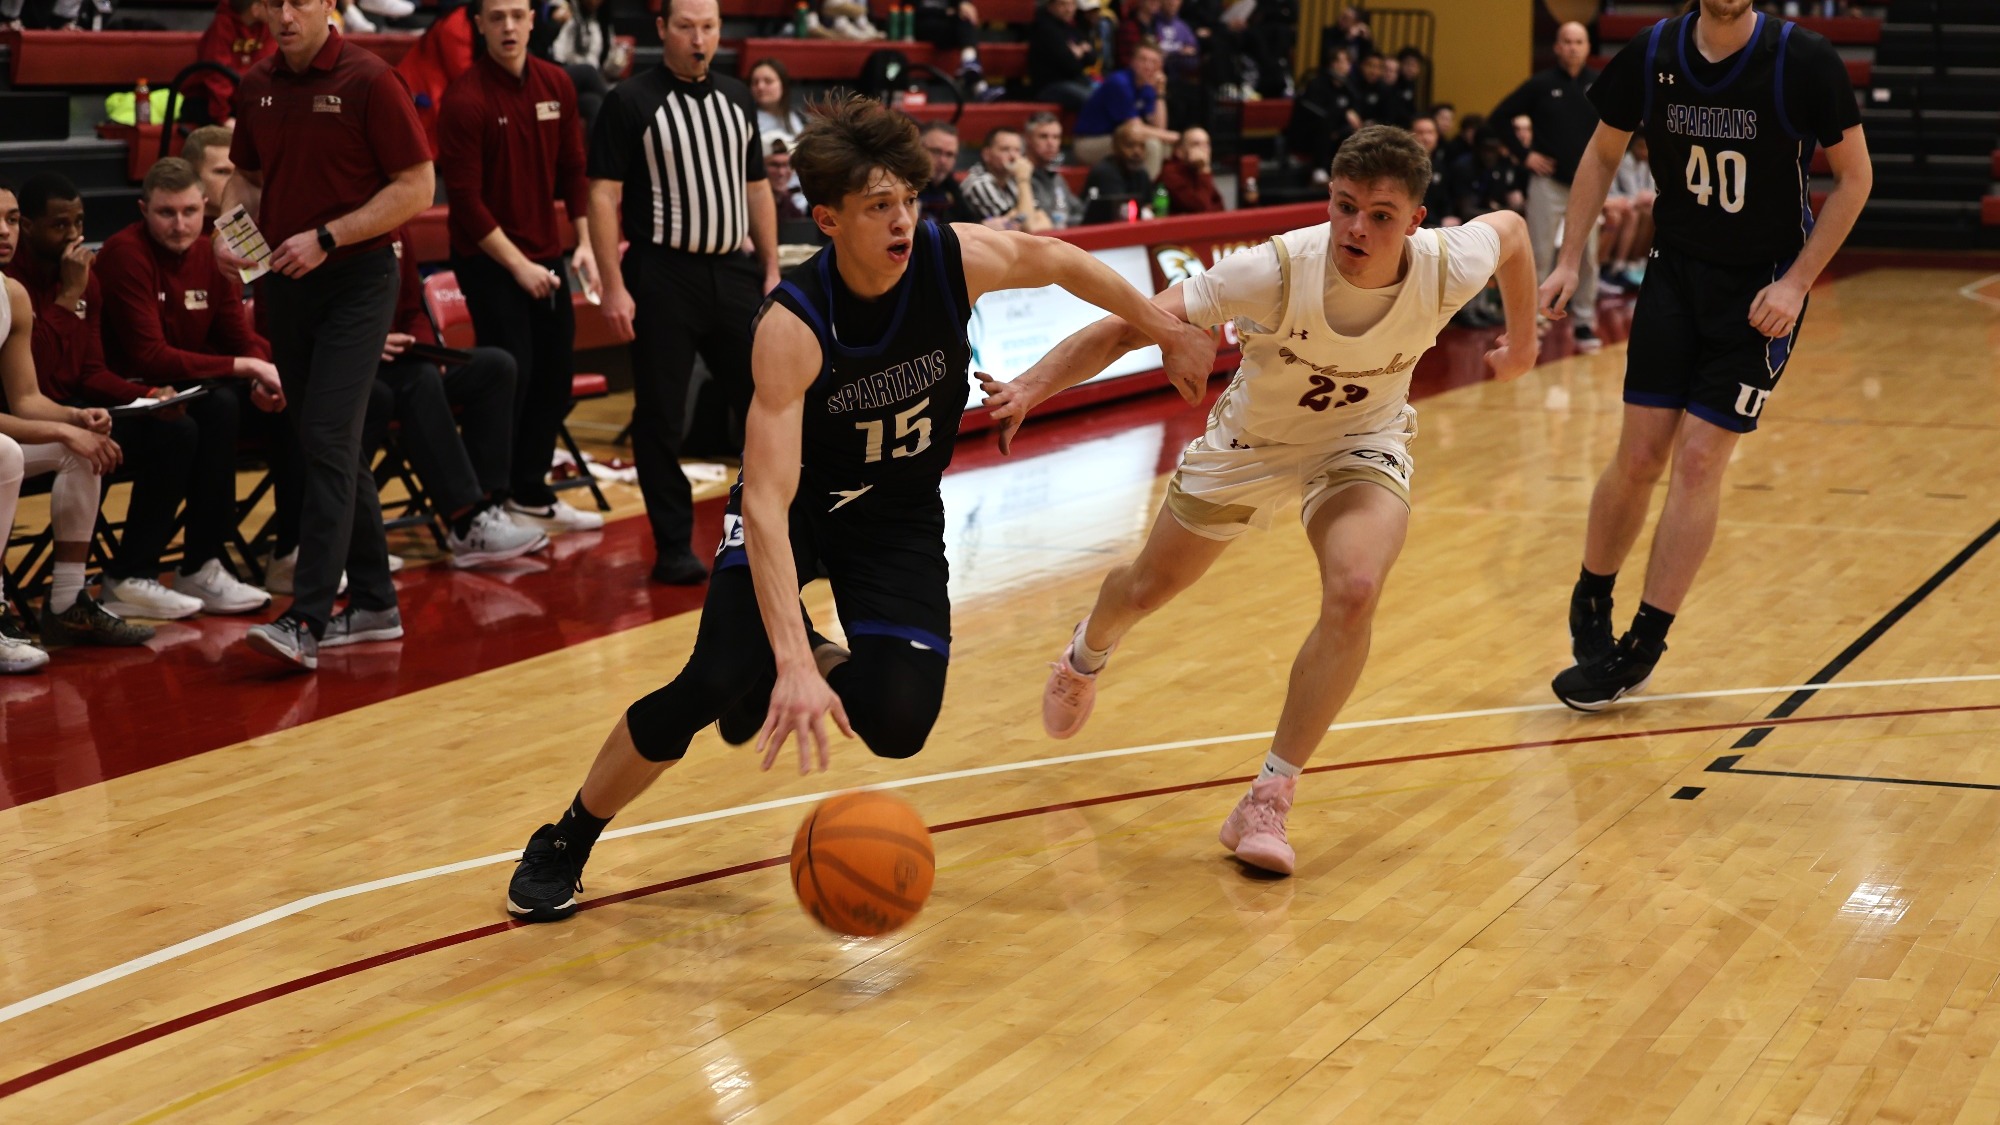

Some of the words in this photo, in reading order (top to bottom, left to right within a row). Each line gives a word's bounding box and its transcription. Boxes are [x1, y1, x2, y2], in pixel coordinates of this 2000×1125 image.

[1667, 103, 1757, 140] SPARTANS
[1685, 144, 1747, 214] 40
[827, 349, 947, 414] SPARTANS
[855, 396, 932, 464] 15
